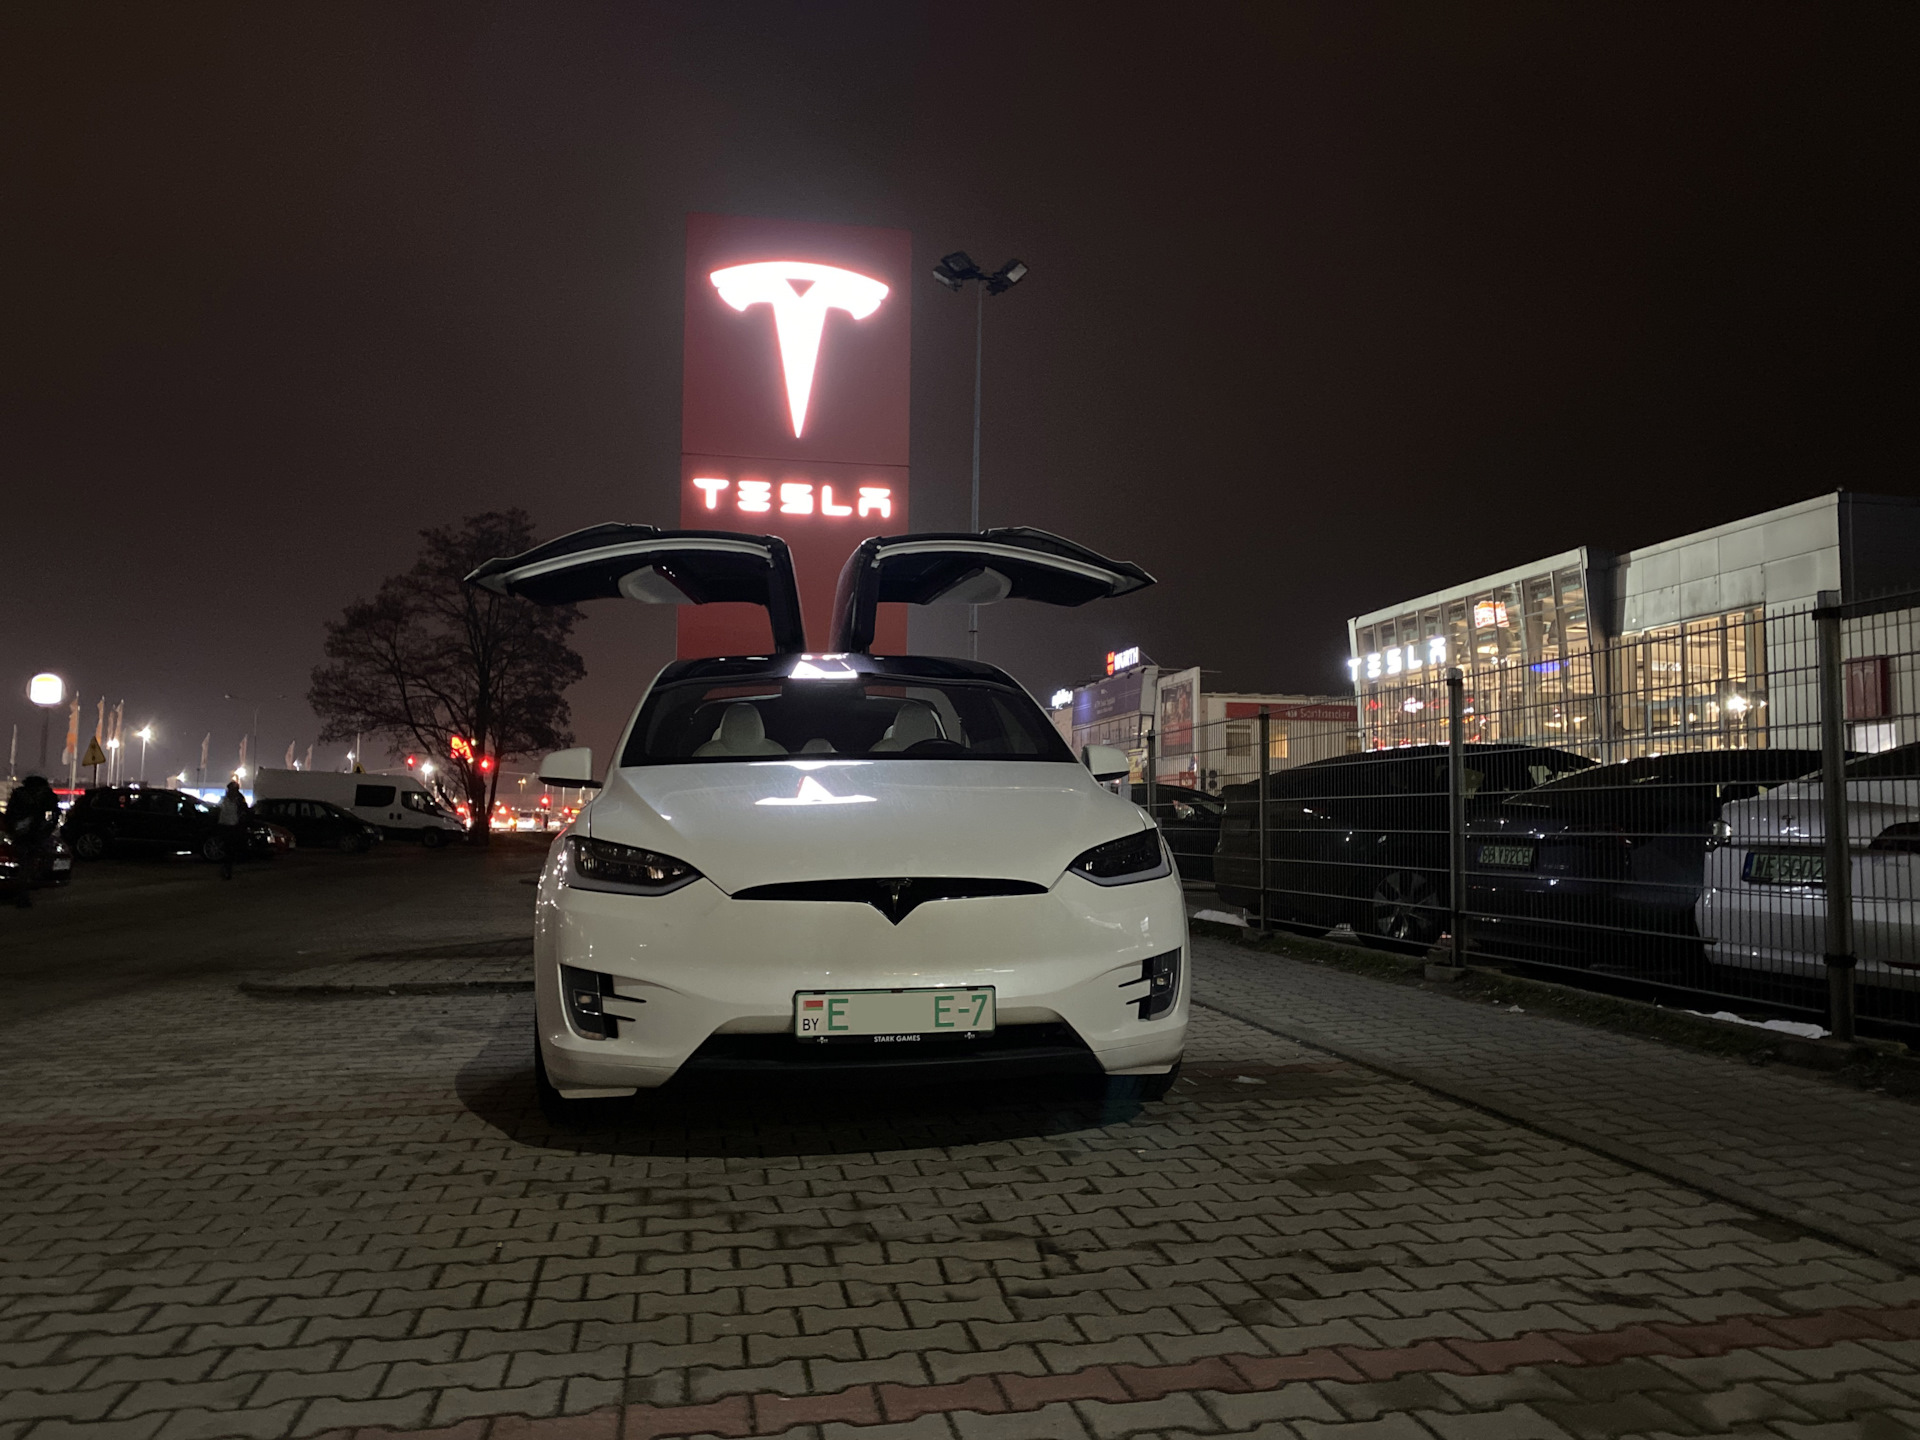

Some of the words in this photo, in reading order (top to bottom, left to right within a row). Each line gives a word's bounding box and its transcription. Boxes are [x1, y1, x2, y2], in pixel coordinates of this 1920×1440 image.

[692, 477, 892, 519] TESLA
[1347, 636, 1447, 682] TESLA
[1300, 705, 1351, 720] Santander
[934, 994, 988, 1028] E-7
[802, 1018, 819, 1032] BY
[873, 1035, 895, 1043] STARK
[896, 1034, 921, 1042] GAMES
